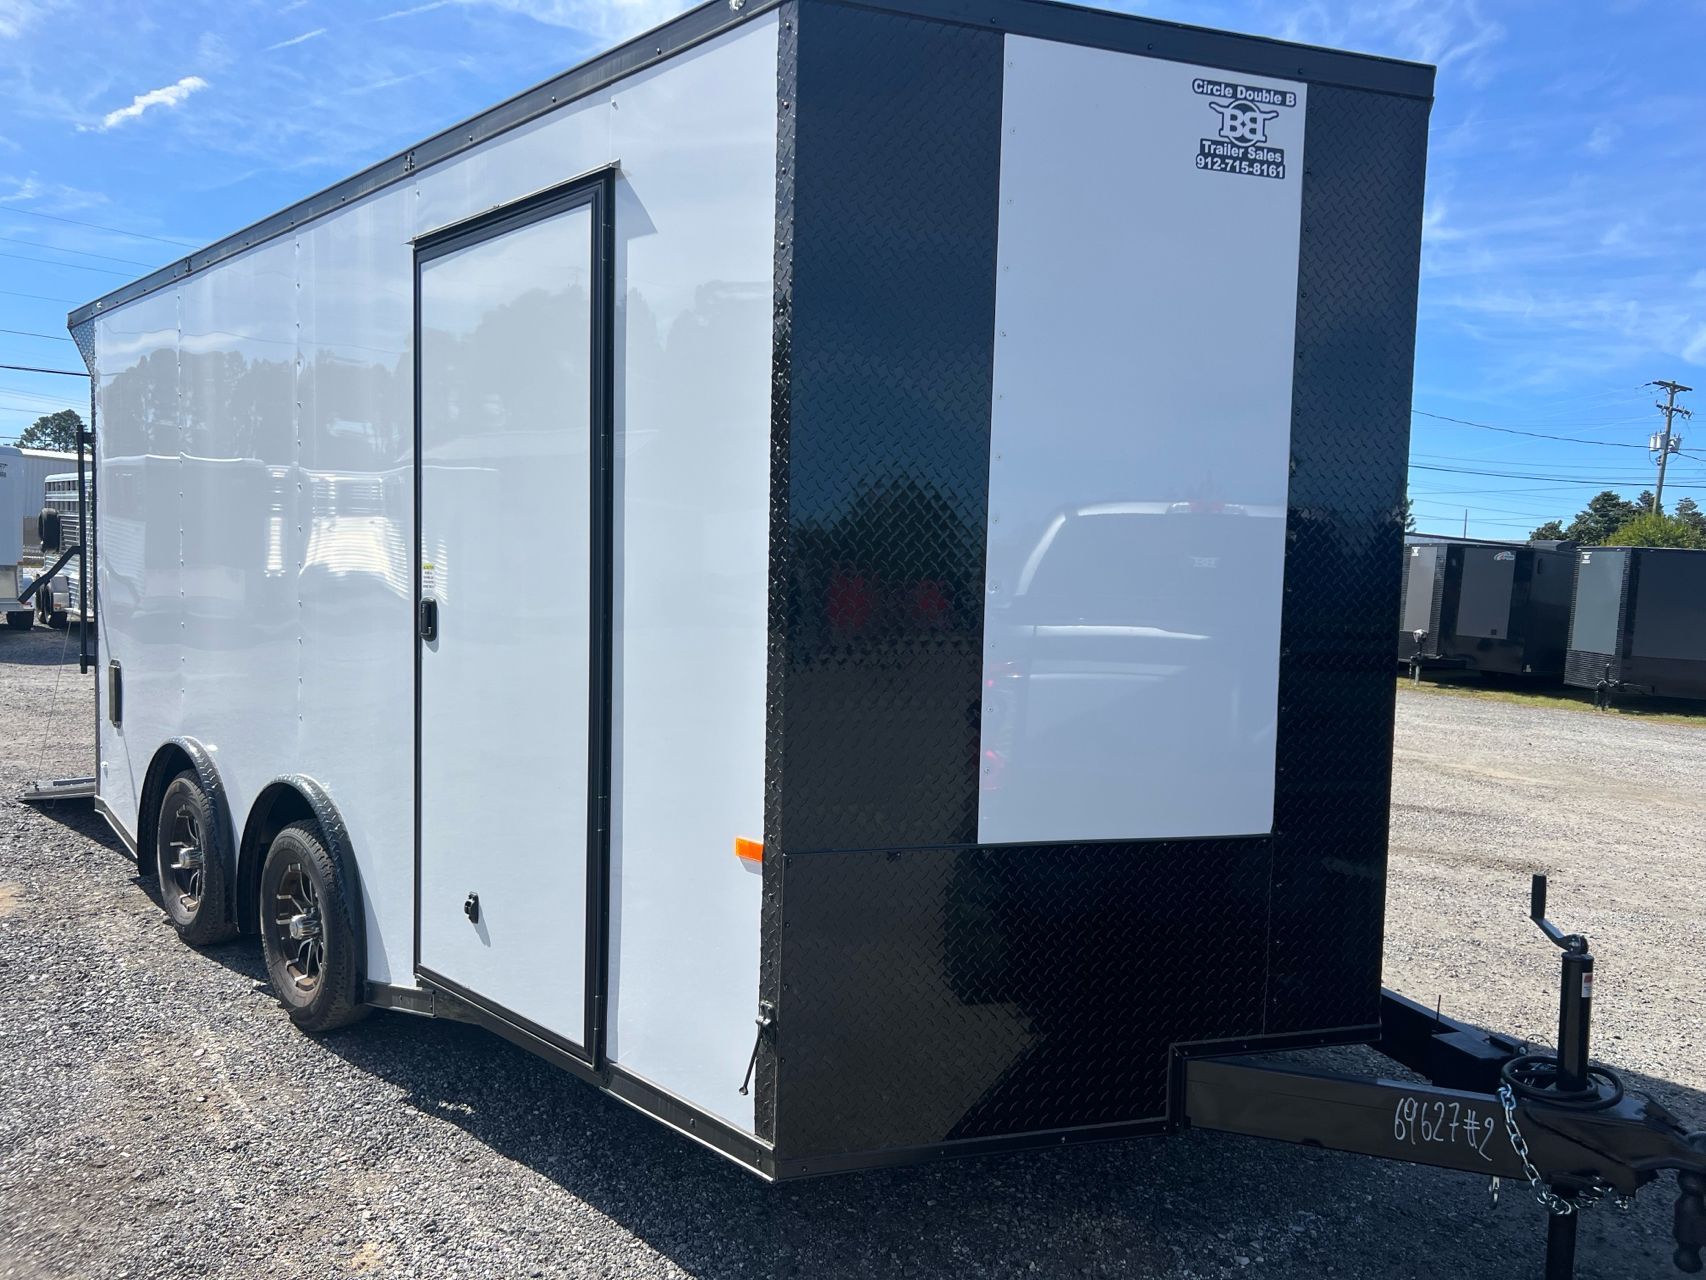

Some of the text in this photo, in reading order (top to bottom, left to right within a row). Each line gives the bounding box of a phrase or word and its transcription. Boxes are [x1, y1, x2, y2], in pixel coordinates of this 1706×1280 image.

[1193, 80, 1295, 106] Circle Double B
[1202, 140, 1282, 163] Trailer Sales
[1196, 155, 1284, 178] 912-715-8161
